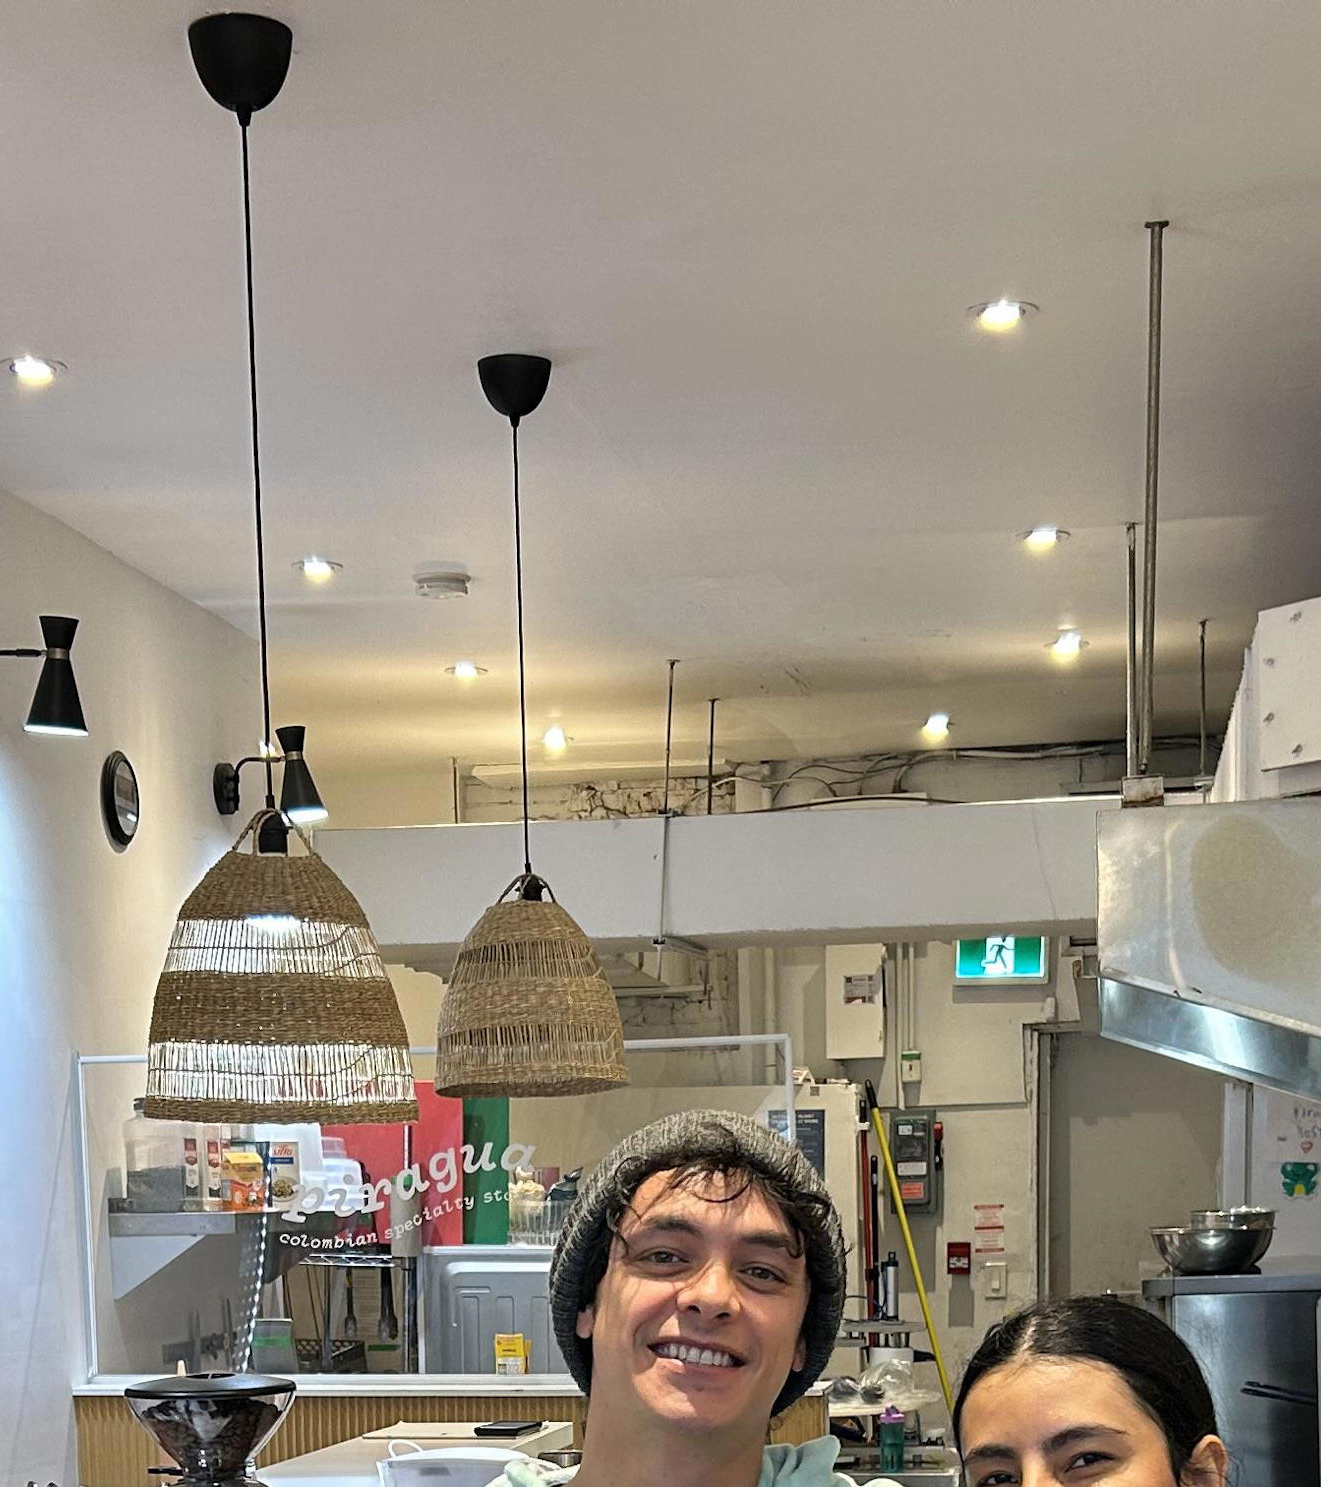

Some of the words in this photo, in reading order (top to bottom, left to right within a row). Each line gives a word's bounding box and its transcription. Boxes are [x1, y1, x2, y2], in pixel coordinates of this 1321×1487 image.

[281, 1141, 537, 1224] piragua
[278, 1232, 378, 1250] colombian
[384, 1196, 475, 1240] specialty
